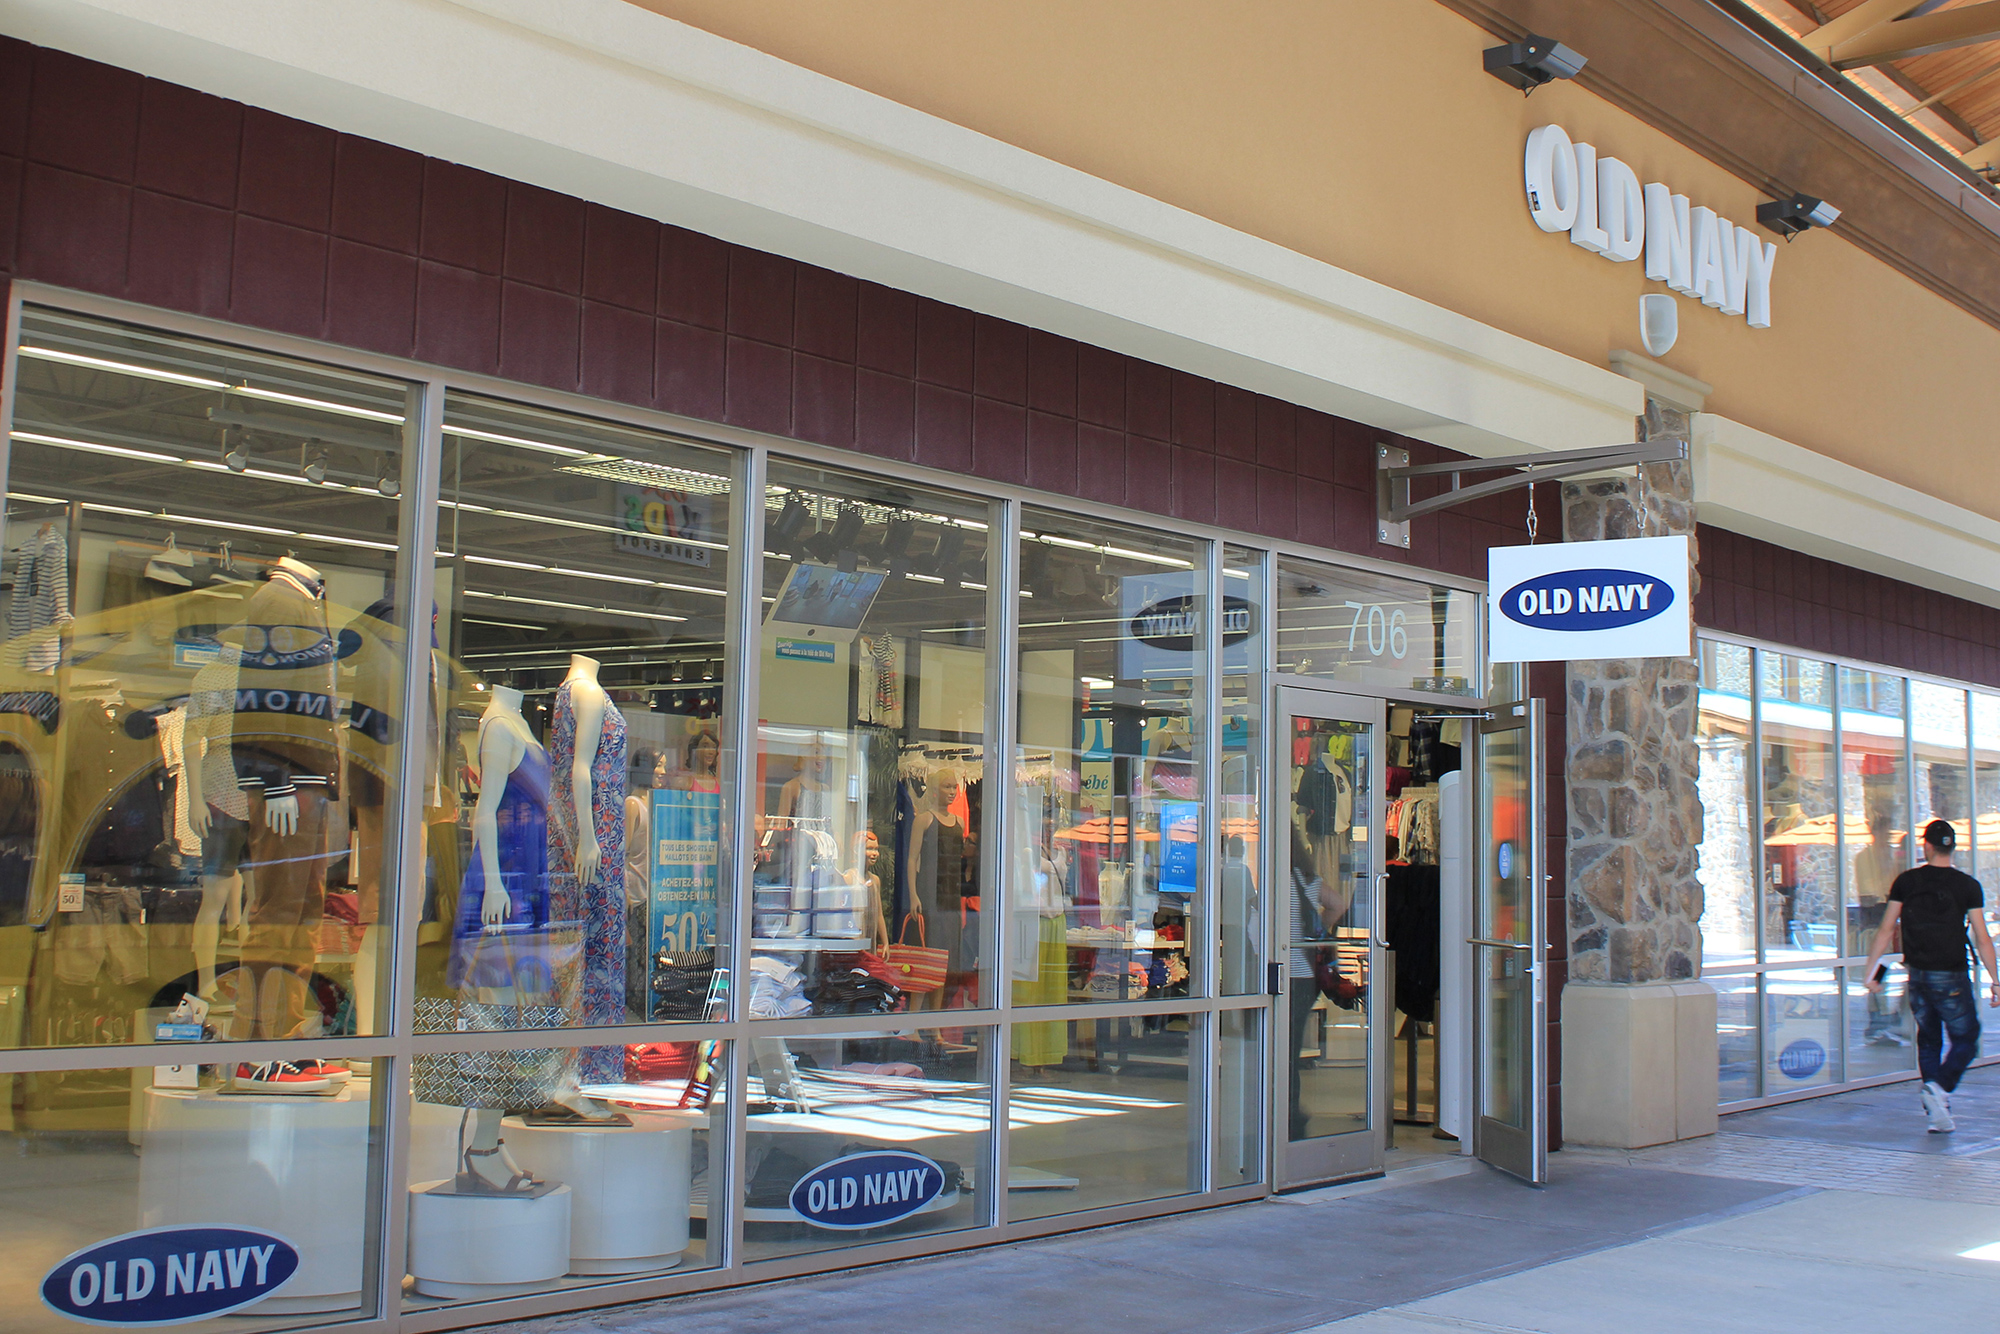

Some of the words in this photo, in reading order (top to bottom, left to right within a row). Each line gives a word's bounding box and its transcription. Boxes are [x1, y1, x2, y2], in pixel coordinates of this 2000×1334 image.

[1524, 123, 1645, 263] OLD
[1643, 181, 1778, 329] NAVY
[1517, 587, 1573, 616] OLD
[1577, 583, 1654, 613] NAVY
[1344, 599, 1408, 660] 706
[1084, 774, 1110, 790] ébé
[661, 843, 675, 852] TOUS
[675, 844, 685, 852] LES
[686, 844, 708, 852] SHORTS
[708, 844, 716, 853] ET
[664, 853, 690, 862] MAILLOTS
[690, 854, 698, 862] DE
[698, 854, 712, 862] BAIN
[661, 877, 703, 888] ACHETEZ-EN
[704, 877, 714, 888] UN
[657, 890, 700, 902] OBTENEZ-EN
[700, 890, 711, 901] UN
[1781, 1051, 1799, 1071] OLD
[1799, 1047, 1821, 1069] NAVY
[807, 1176, 858, 1214] OLD
[863, 1167, 929, 1207] NAVY
[69, 1257, 156, 1307] OLD
[165, 1243, 277, 1297] NAVY
